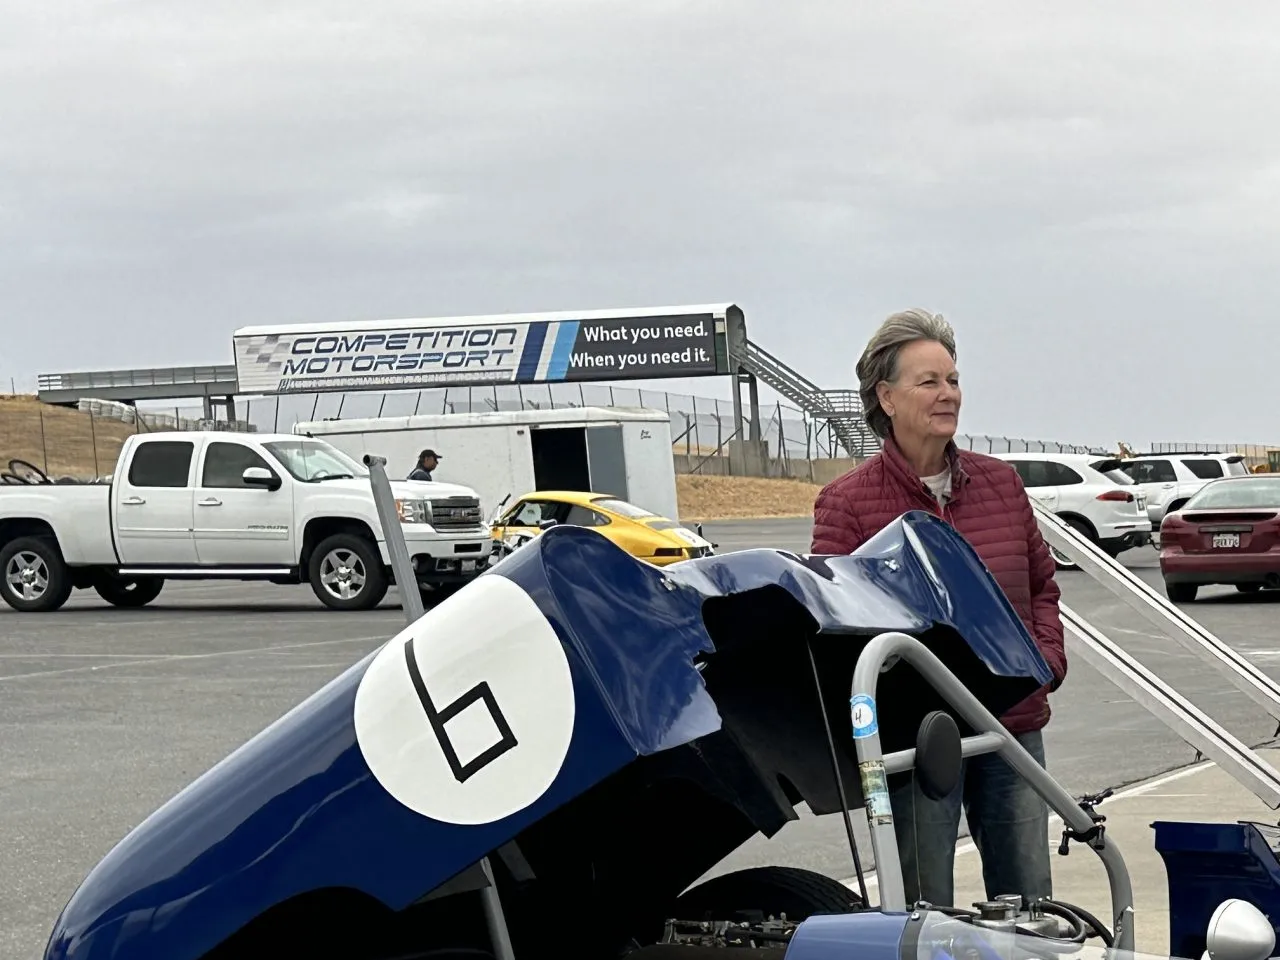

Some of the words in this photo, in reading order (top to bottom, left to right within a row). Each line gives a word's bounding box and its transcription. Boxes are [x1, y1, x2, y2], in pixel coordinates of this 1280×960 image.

[291, 327, 518, 355] COMPETITION
[583, 325, 628, 343] What
[629, 327, 660, 345] you
[664, 321, 709, 338] need.
[283, 349, 514, 376] MOTORSPORT
[568, 352, 615, 368] When
[618, 353, 648, 370] you
[651, 348, 691, 365] need
[694, 347, 711, 362] it.
[404, 637, 519, 784] 6
